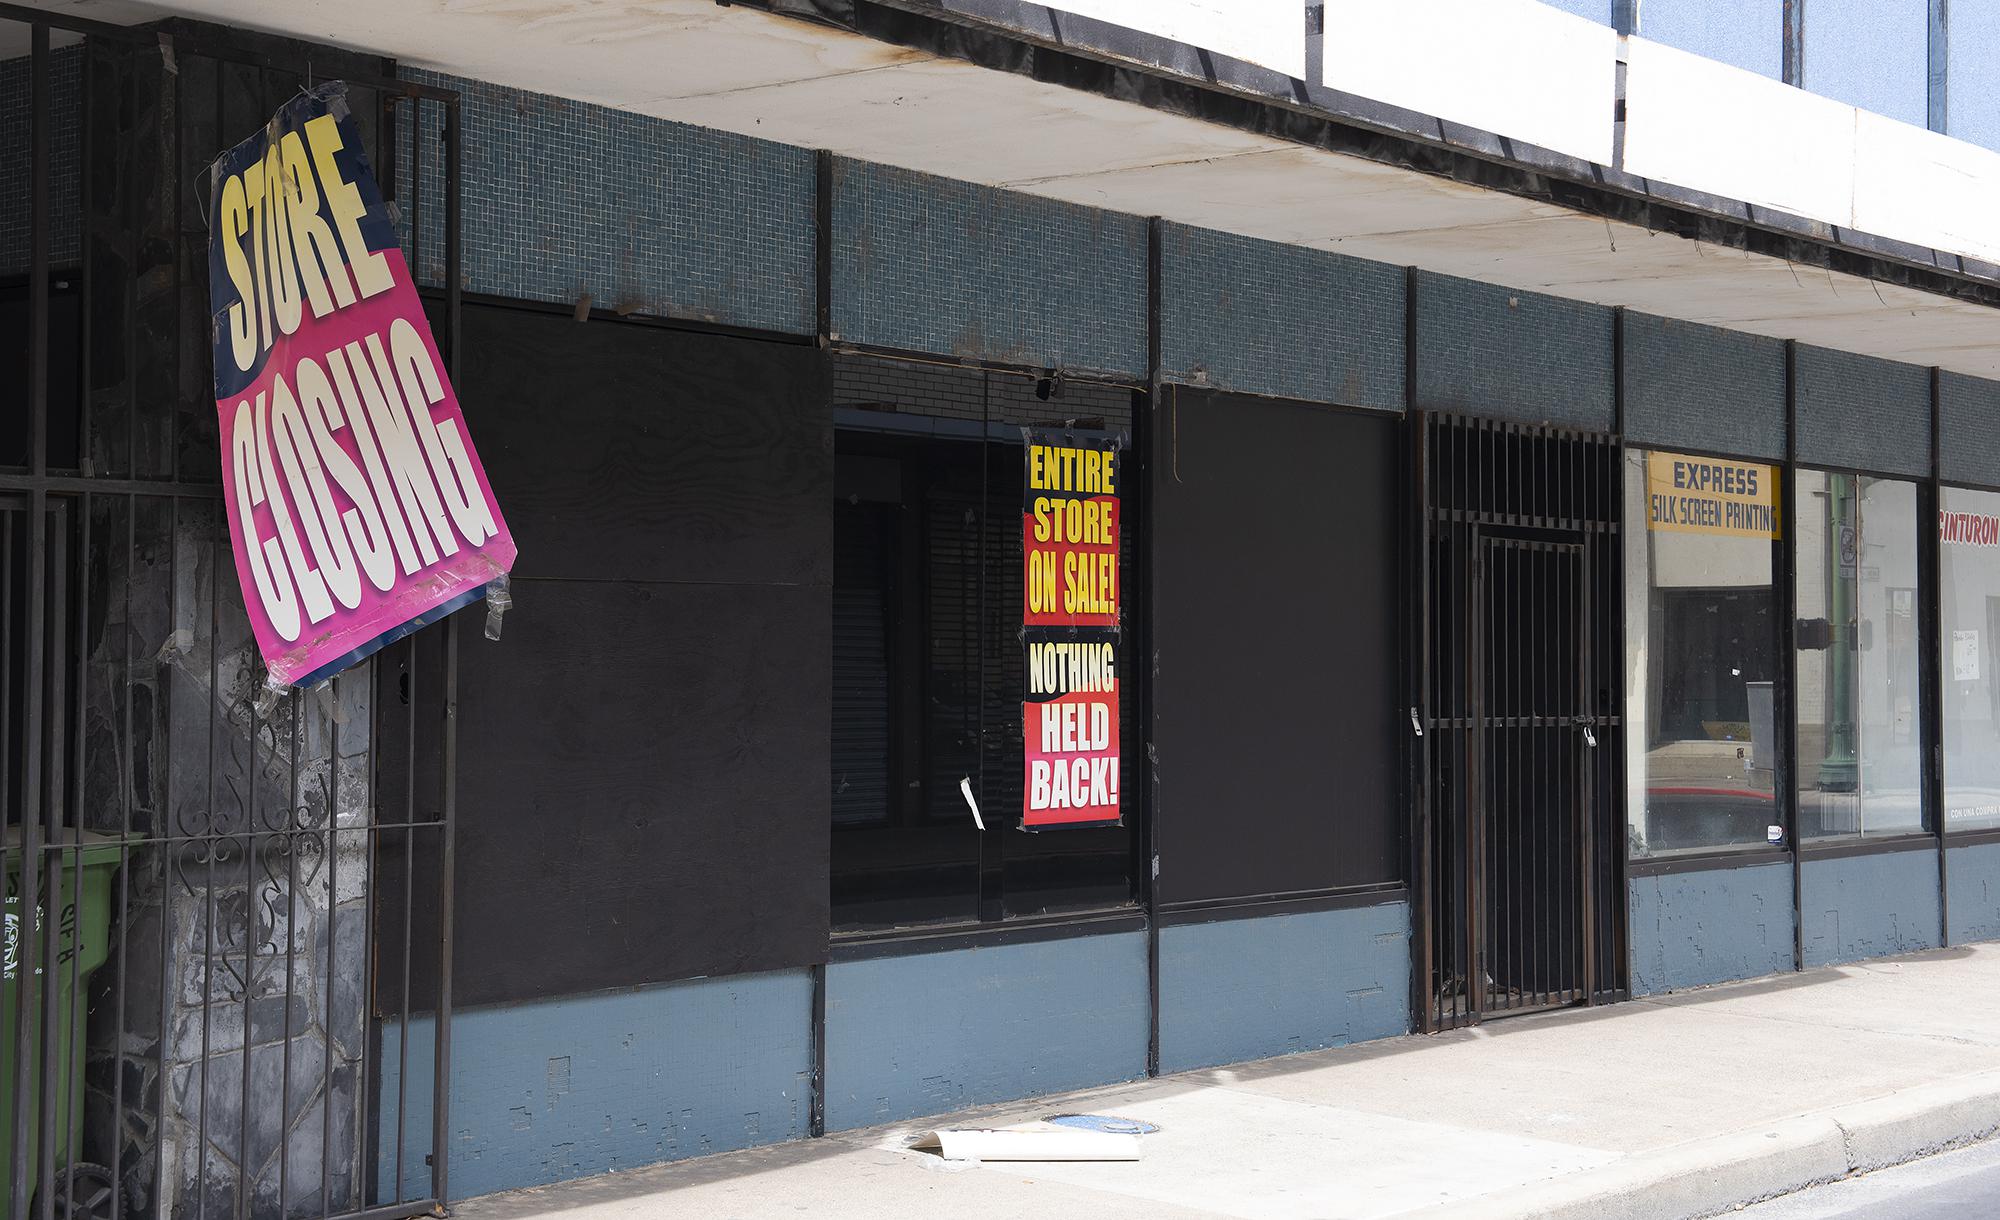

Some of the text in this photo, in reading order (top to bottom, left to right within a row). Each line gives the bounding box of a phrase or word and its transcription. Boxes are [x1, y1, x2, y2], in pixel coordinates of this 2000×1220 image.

[220, 112, 396, 372] STORE
[232, 318, 499, 643] CLOSING
[1030, 445, 1115, 495] ENTIRE
[1673, 461, 1758, 496] EXPRESS
[1033, 496, 1114, 545] STORE
[1651, 494, 1777, 533] SILK SCREEN PRINTING
[1028, 549, 1116, 615] ON SALE!
[1030, 642, 1115, 694] NOTHING
[1041, 702, 1109, 753] HELD
[1030, 756, 1119, 810] BACK!
